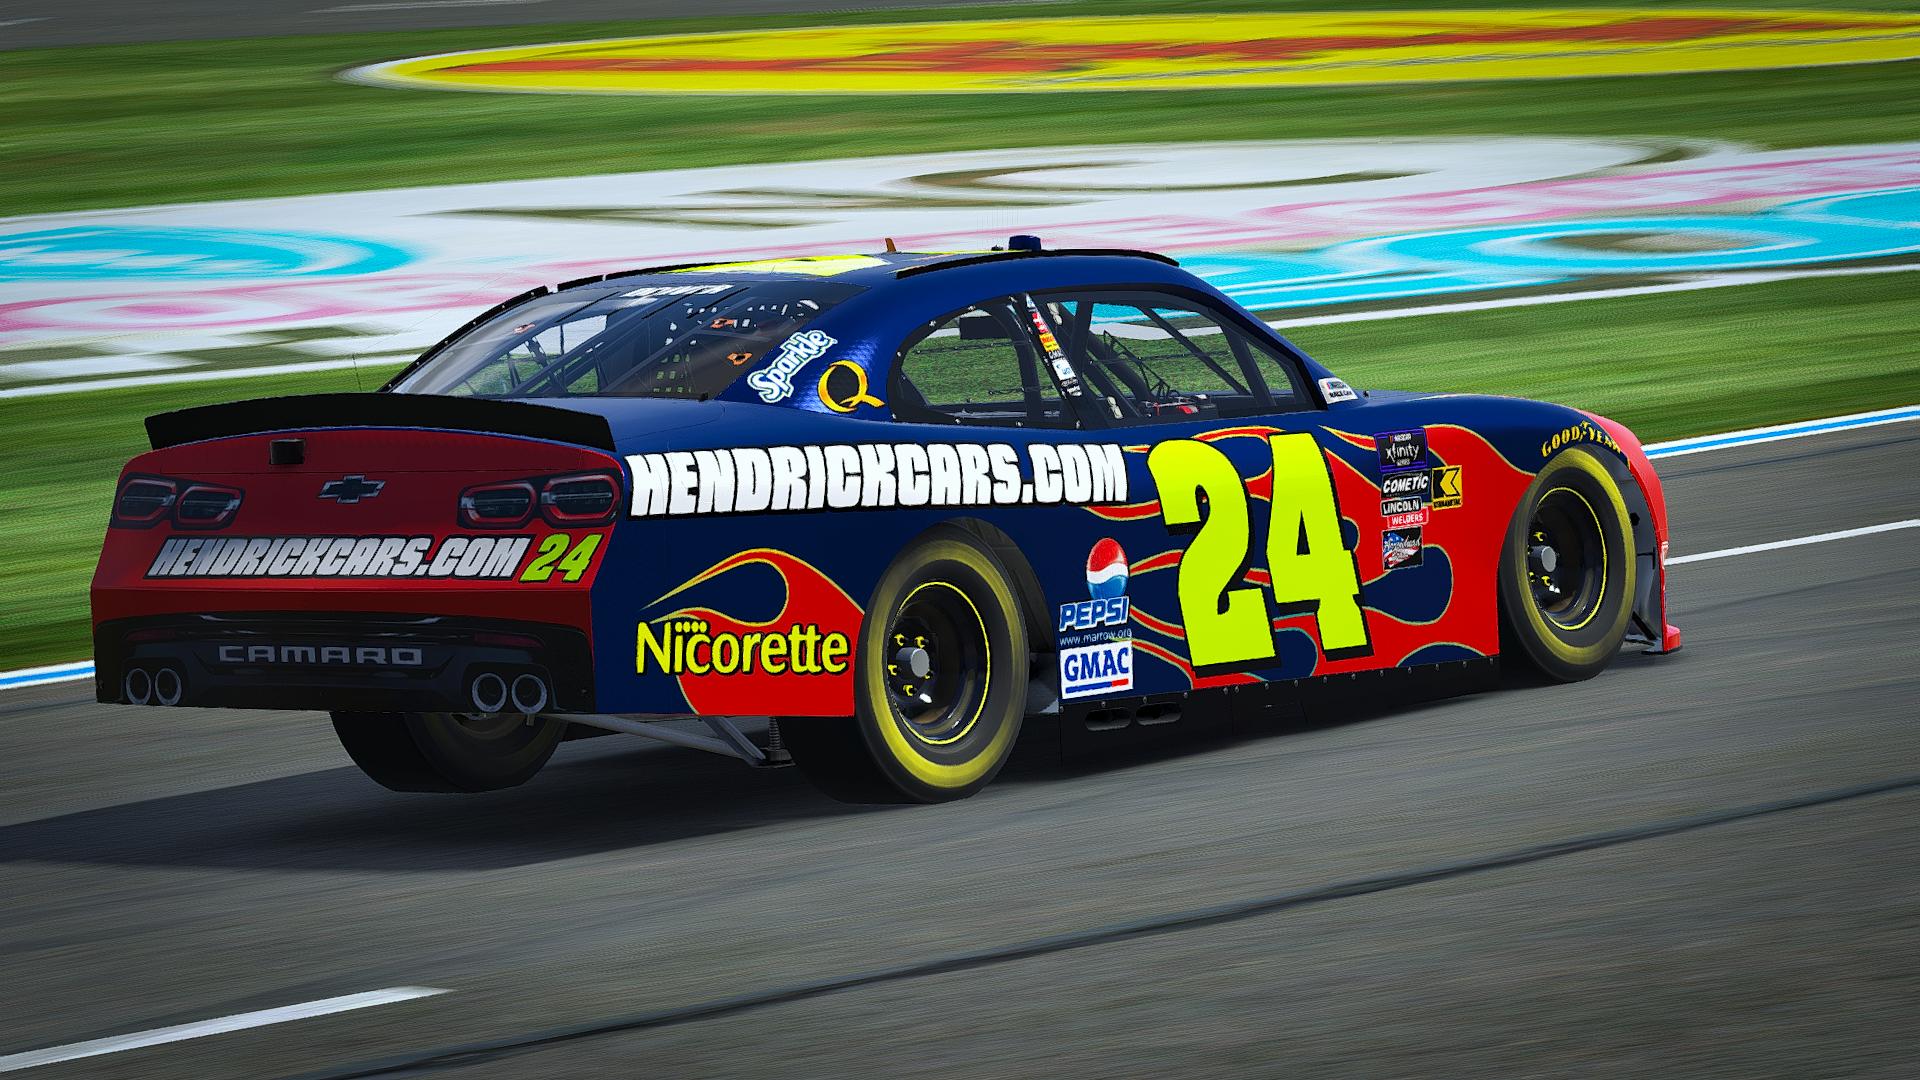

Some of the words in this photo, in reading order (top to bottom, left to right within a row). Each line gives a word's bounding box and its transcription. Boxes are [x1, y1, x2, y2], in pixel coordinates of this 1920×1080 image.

[749, 331, 837, 402] Sparkle
[818, 360, 885, 412] Q
[1386, 443, 1419, 463] xfinity
[1541, 420, 1621, 457] GOODYEAR
[625, 443, 1128, 516] HENDRICKCARS.COM
[1383, 475, 1429, 494] COMETIC
[1382, 500, 1419, 515] LINCOLN
[1391, 513, 1424, 525] WELDERS
[147, 537, 530, 577] HENDRICKCARS.COM
[519, 533, 604, 583] 24
[1147, 432, 1368, 667] 24
[1059, 596, 1129, 632] PEPSI
[636, 621, 849, 674] Nicorette
[1060, 628, 1132, 646] www.marrow.org
[218, 645, 423, 666] CAMARO
[1064, 647, 1129, 682] GMAC
